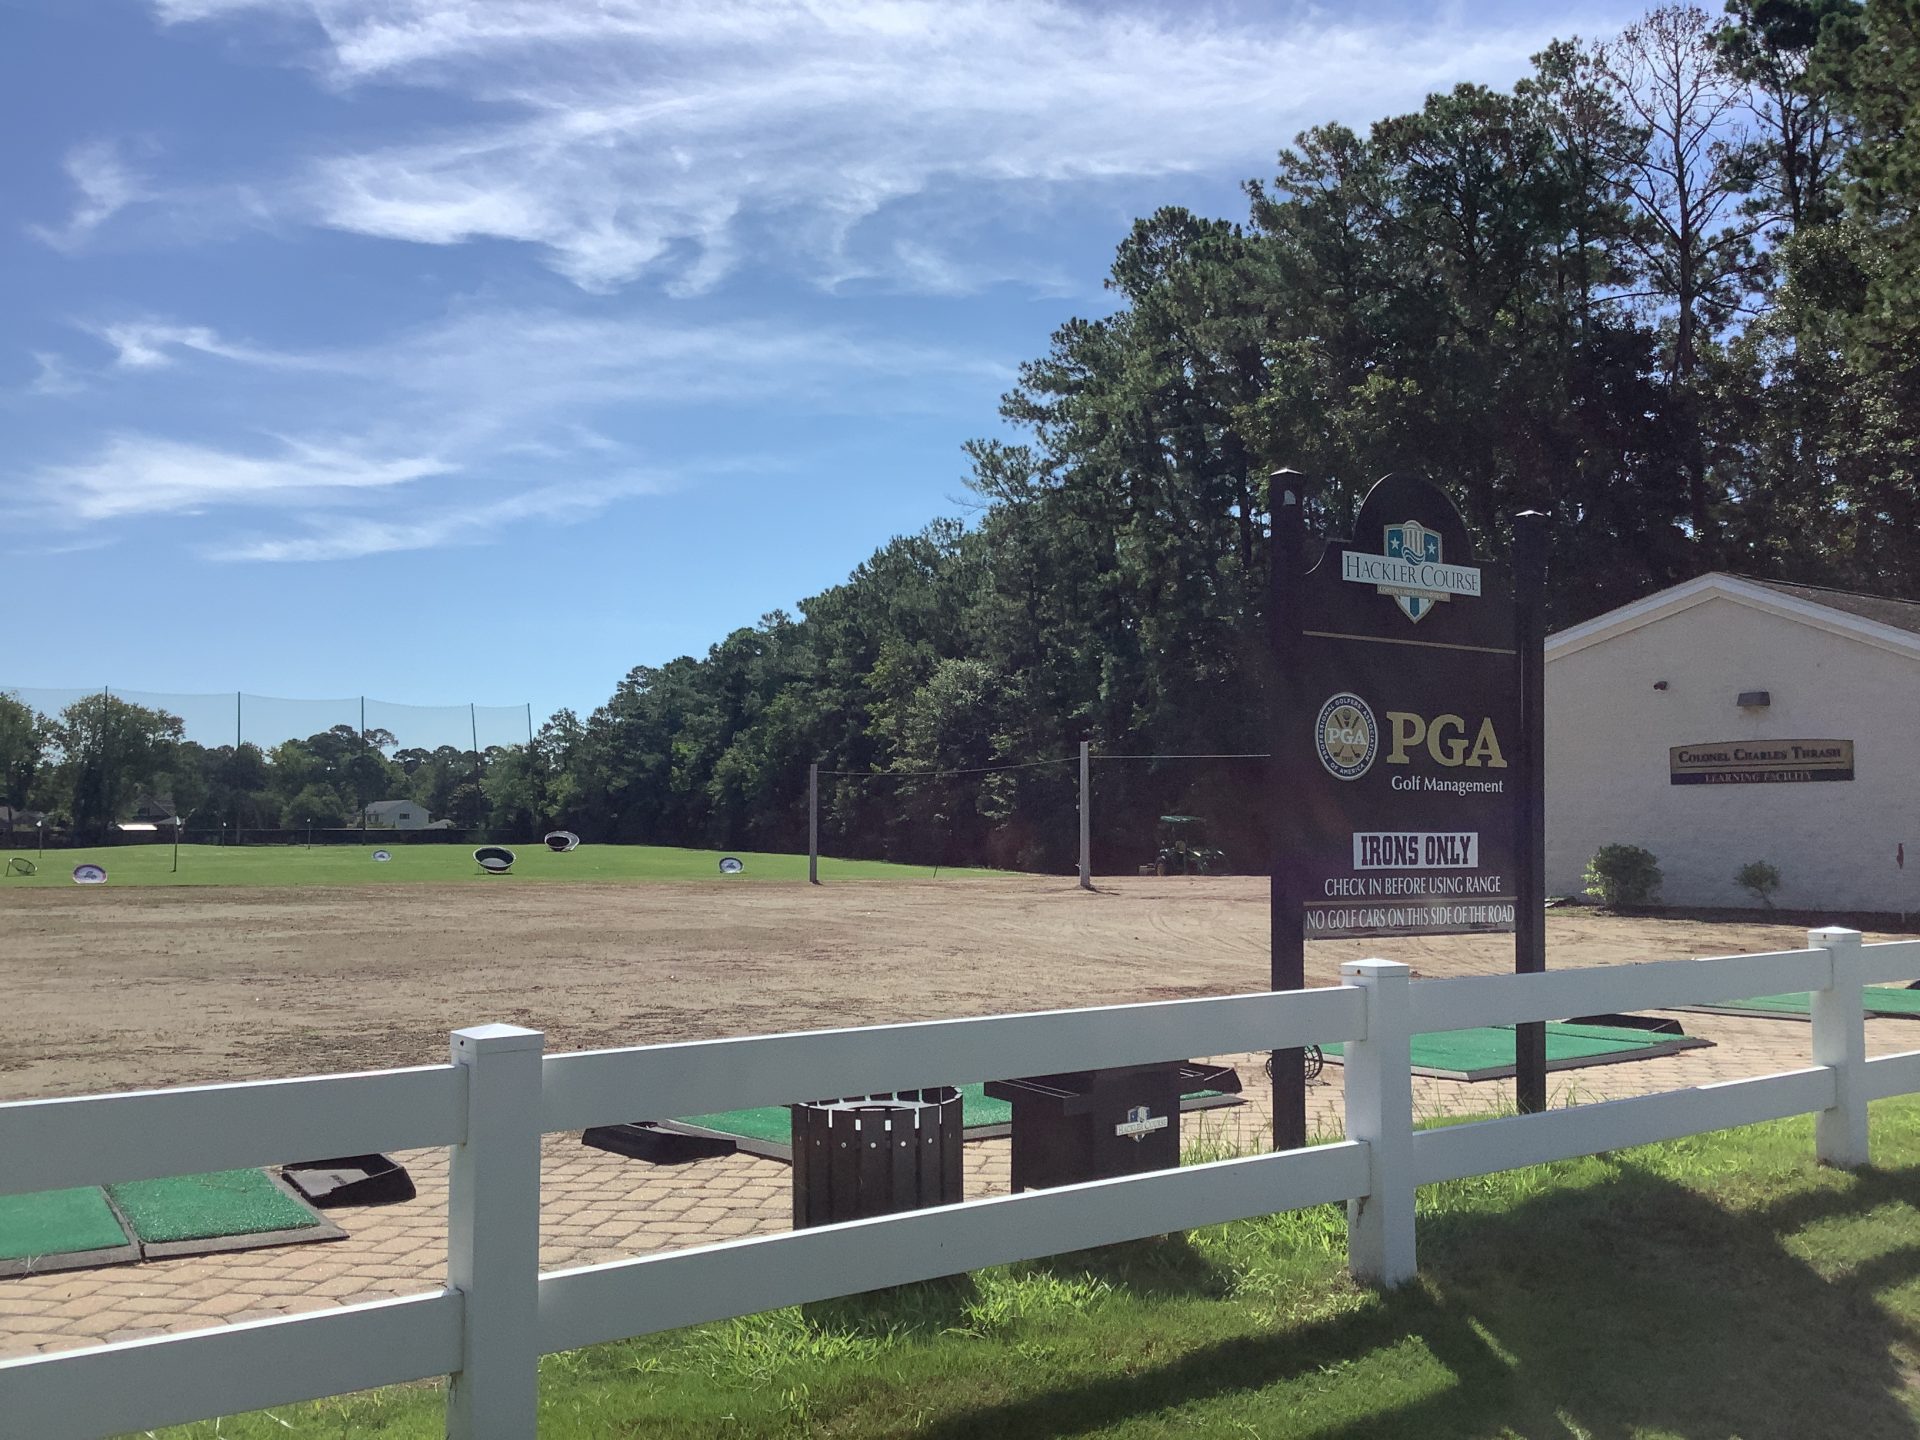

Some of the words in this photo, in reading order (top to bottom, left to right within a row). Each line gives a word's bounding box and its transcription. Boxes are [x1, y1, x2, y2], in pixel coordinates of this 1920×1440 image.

[1346, 555, 1417, 584] HACKLER
[1421, 565, 1479, 592] COURSE
[1327, 727, 1367, 745] PGA
[1386, 711, 1508, 768] PGA
[1678, 750, 1730, 763] COLONEL
[1733, 749, 1787, 761] CHARLES
[1791, 746, 1841, 760] THRASH
[1391, 775, 1420, 791] Golf
[1424, 776, 1503, 796] Management
[1705, 773, 1760, 783] LEARNING
[1763, 771, 1813, 781] FACILITY
[1360, 835, 1419, 866] IRONS
[1425, 835, 1471, 866] ONLY
[1324, 878, 1366, 896] CHECK
[1369, 878, 1382, 895] IN
[1384, 877, 1426, 895] BEFORE
[1429, 876, 1463, 894] USING
[1466, 876, 1501, 893] RANGE
[1306, 910, 1325, 929] NO
[1327, 909, 1356, 929] GOLF
[1359, 908, 1386, 928] CARS
[1387, 908, 1405, 927] ON
[1407, 907, 1429, 926] THIS
[1430, 906, 1452, 925] SIDE
[1454, 905, 1468, 924] OF
[1469, 905, 1486, 924] THE
[1488, 904, 1515, 923] ROAD
